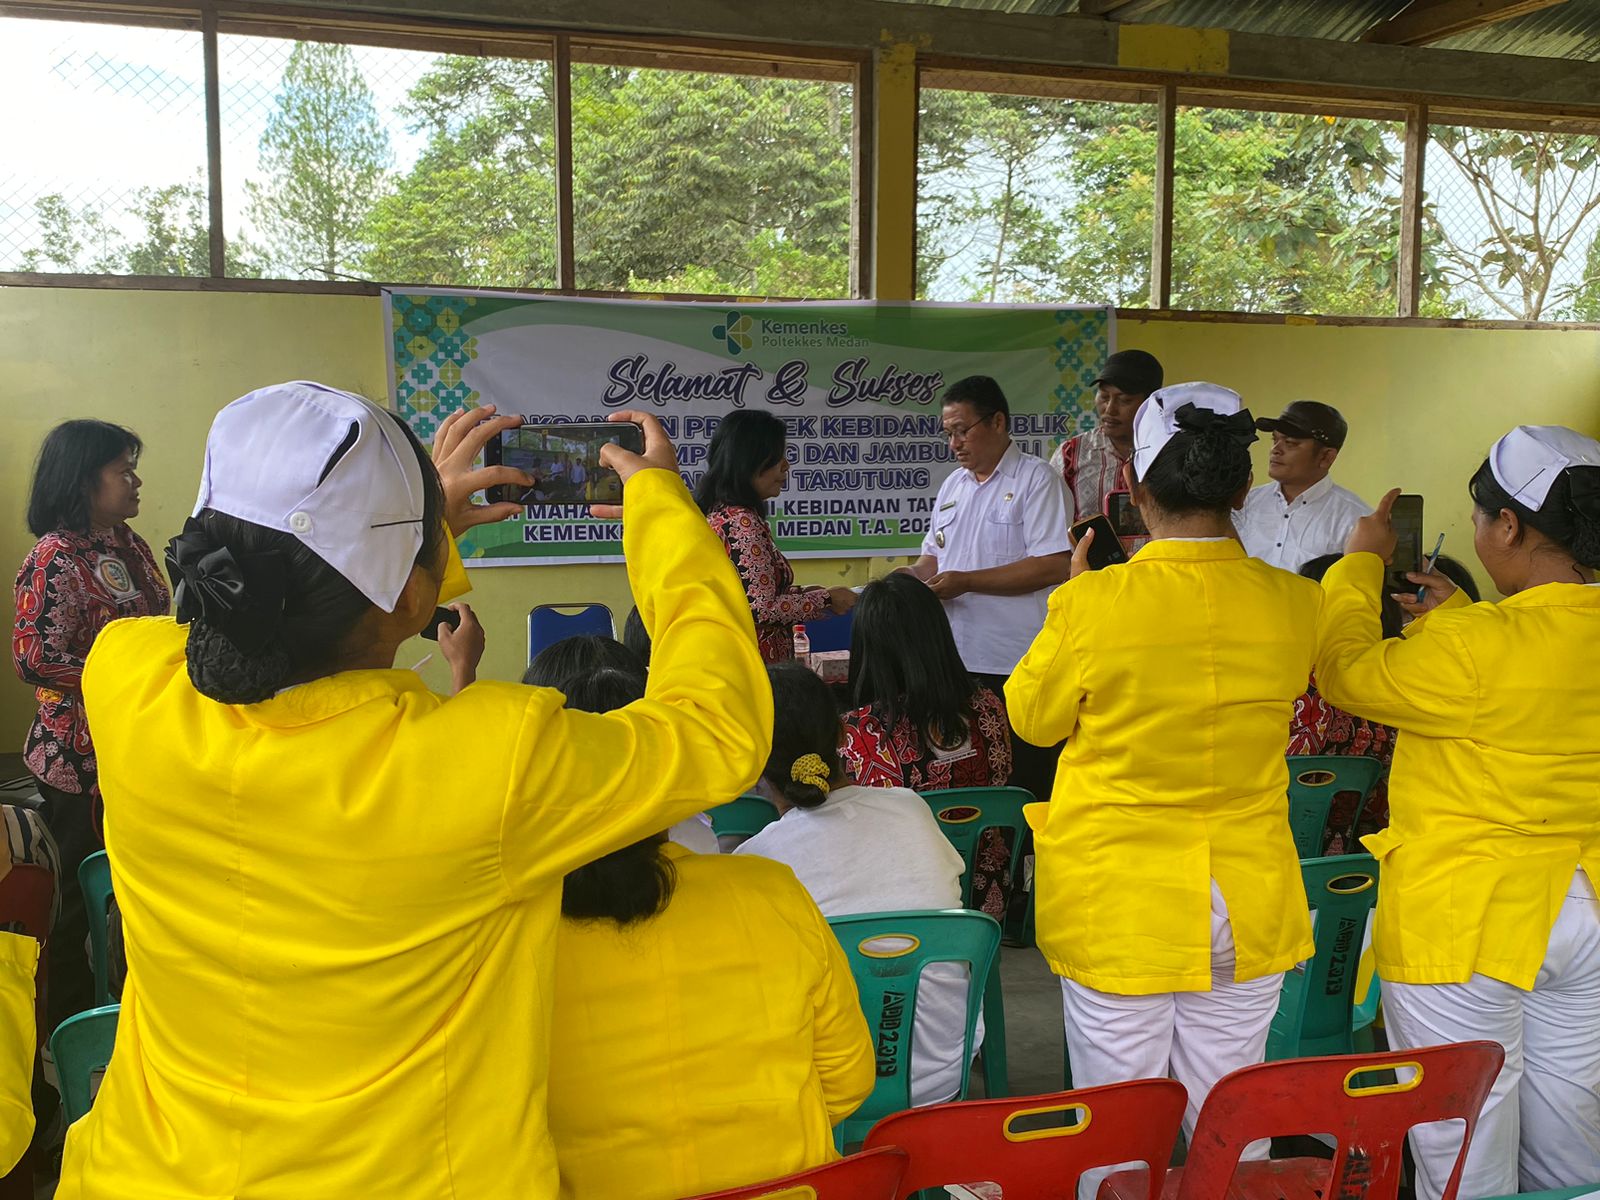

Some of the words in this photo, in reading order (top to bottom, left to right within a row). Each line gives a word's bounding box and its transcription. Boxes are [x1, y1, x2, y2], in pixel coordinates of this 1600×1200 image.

[762, 320, 847, 335] Kemenkes
[762, 335, 823, 347] Poltekkes
[827, 336, 870, 347] Medan
[602, 354, 763, 408] Selamat
[766, 359, 809, 406] &
[826, 356, 945, 408] Sukses
[804, 442, 859, 464] DAN
[863, 441, 957, 464] JAMBU
[793, 468, 930, 491] TARUTUNG
[784, 499, 899, 515] KEBIDANAN
[778, 519, 850, 536] MEDAN
[859, 519, 891, 534] T.A.
